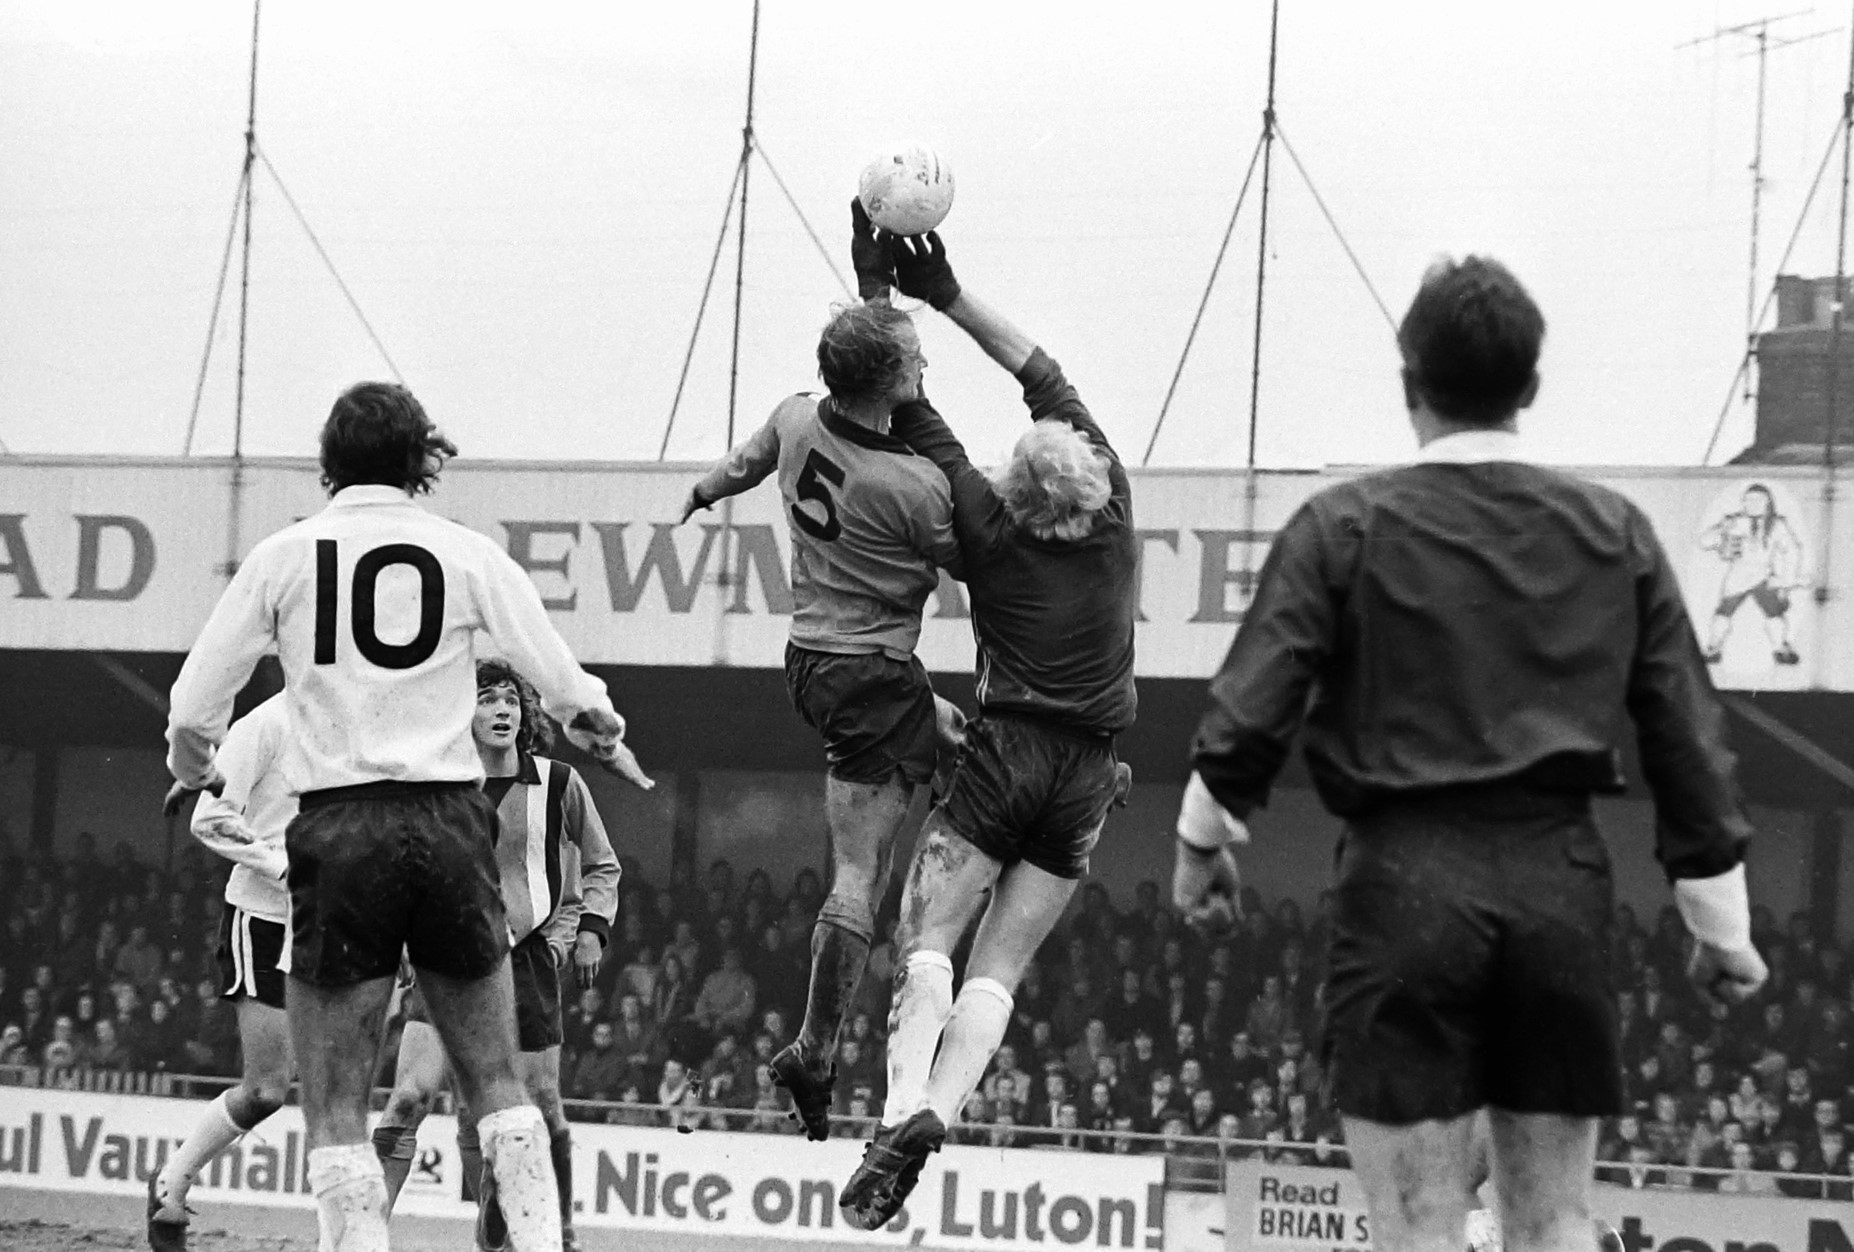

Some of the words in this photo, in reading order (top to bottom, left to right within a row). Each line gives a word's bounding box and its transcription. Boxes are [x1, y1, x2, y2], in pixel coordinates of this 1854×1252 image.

[791, 447, 845, 542] 5
[314, 539, 445, 669] 10
[60, 1114, 312, 1193] Vauhall
[1260, 1177, 1339, 1205] Read
[753, 1175, 926, 1247] on,
[940, 1171, 1165, 1249] Luton!
[1260, 1208, 1344, 1241] BRIAN
